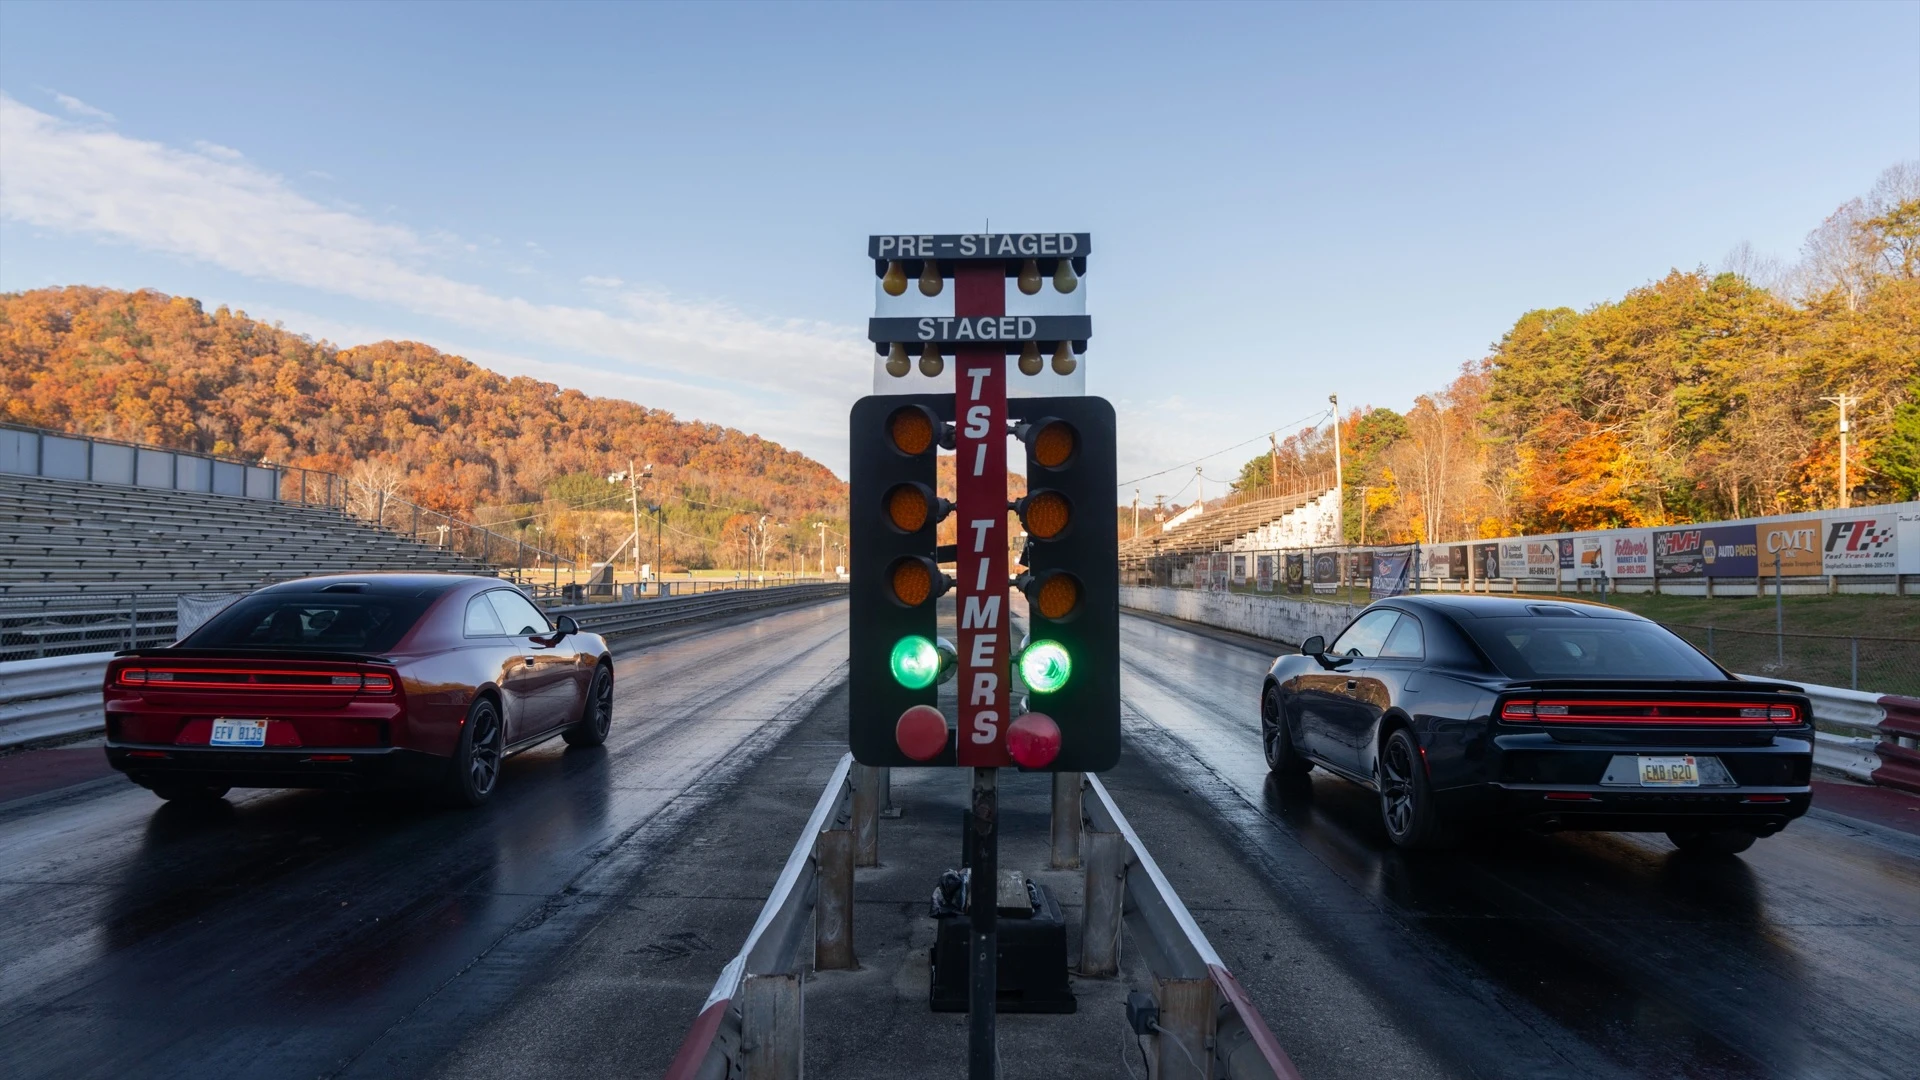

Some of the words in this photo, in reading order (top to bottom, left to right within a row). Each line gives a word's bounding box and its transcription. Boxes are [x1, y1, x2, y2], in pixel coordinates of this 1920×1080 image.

[917, 317, 1037, 340] STAGED
[964, 368, 992, 476] TSI
[1508, 544, 1522, 552] United
[1718, 545, 1735, 558] AUTO
[1735, 543, 1757, 557] PARTS
[1766, 528, 1816, 555] CMT
[961, 519, 1001, 744] TIMERS
[214, 726, 233, 739] EFV
[238, 727, 262, 740] 8139
[1671, 765, 1692, 780] 620
